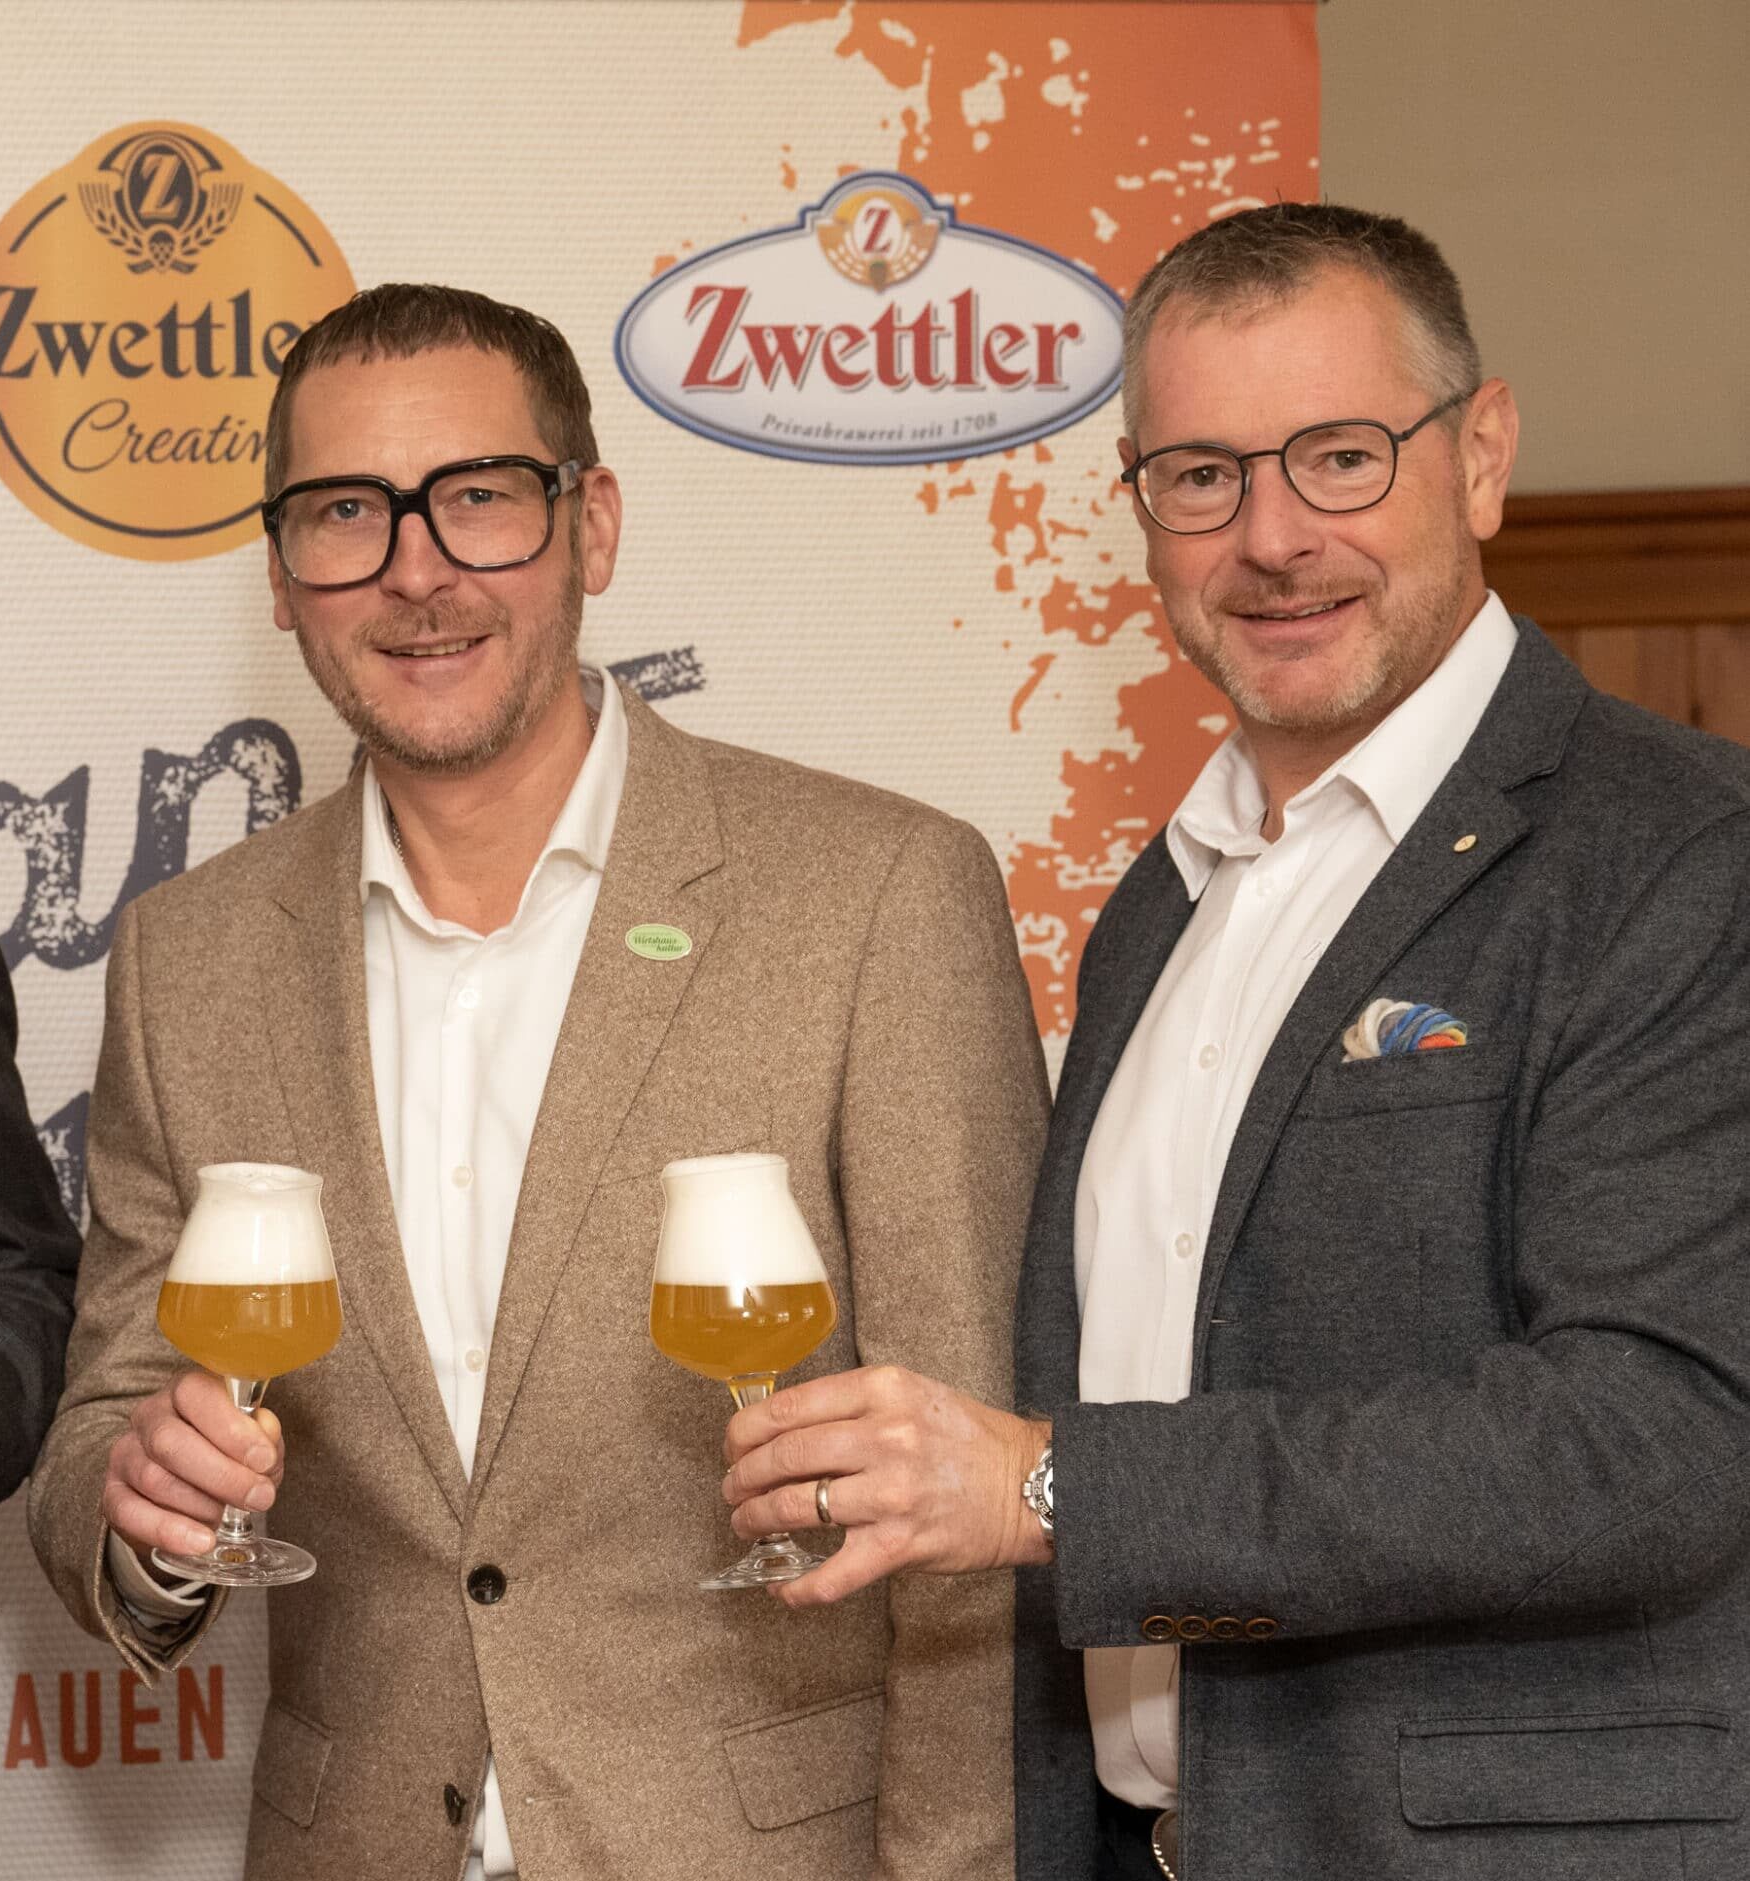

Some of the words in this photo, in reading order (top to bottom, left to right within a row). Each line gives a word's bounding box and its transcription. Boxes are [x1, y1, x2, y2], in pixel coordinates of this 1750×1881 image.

[862, 206, 893, 254] Z
[680, 284, 1083, 394] Zwettler
[761, 412, 904, 441] Privatbrauerei
[911, 423, 943, 439] seit
[952, 411, 998, 436] 1708
